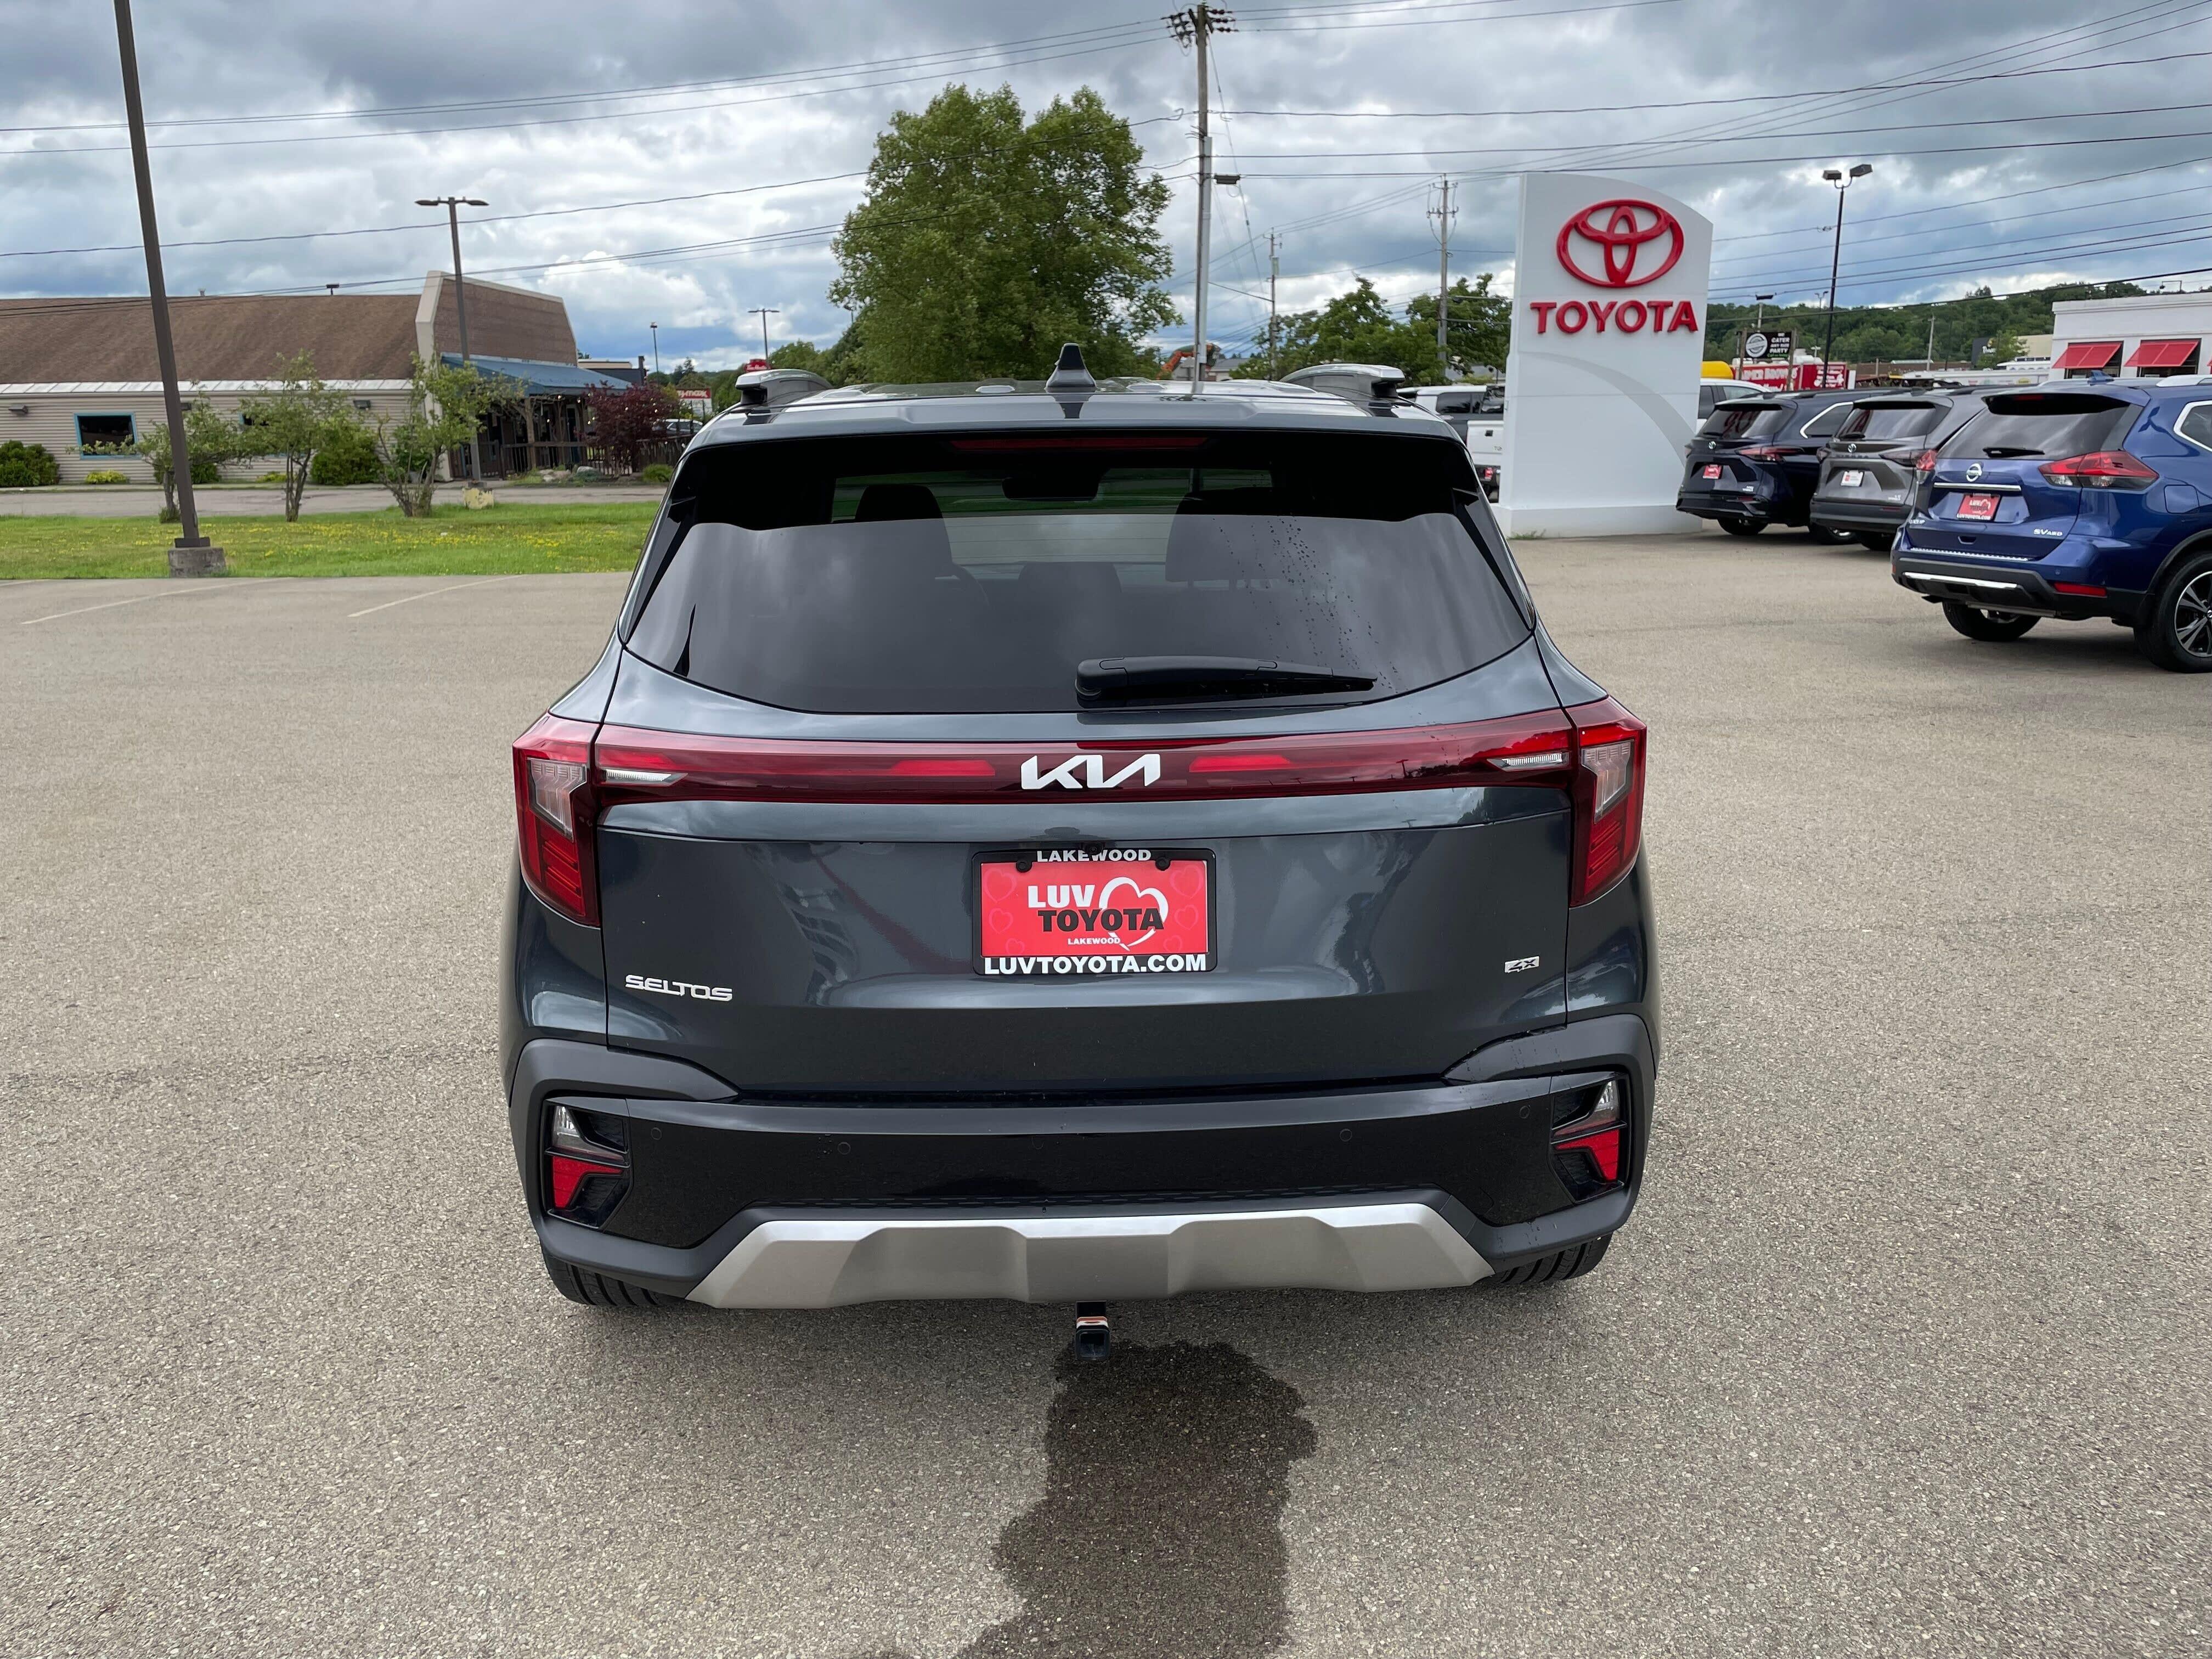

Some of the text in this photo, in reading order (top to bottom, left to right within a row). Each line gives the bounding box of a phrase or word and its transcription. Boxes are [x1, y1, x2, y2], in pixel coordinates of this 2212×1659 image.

[1530, 300, 1699, 334] TOYOTA
[1021, 753, 1161, 789] KIA
[1037, 849, 1152, 862] LAKEWOOD
[1028, 884, 1096, 908] LUV
[1038, 909, 1164, 932] TOYOTA
[984, 954, 1206, 975] LUVTOYOTA.COM
[625, 974, 733, 1002] SELTOS
